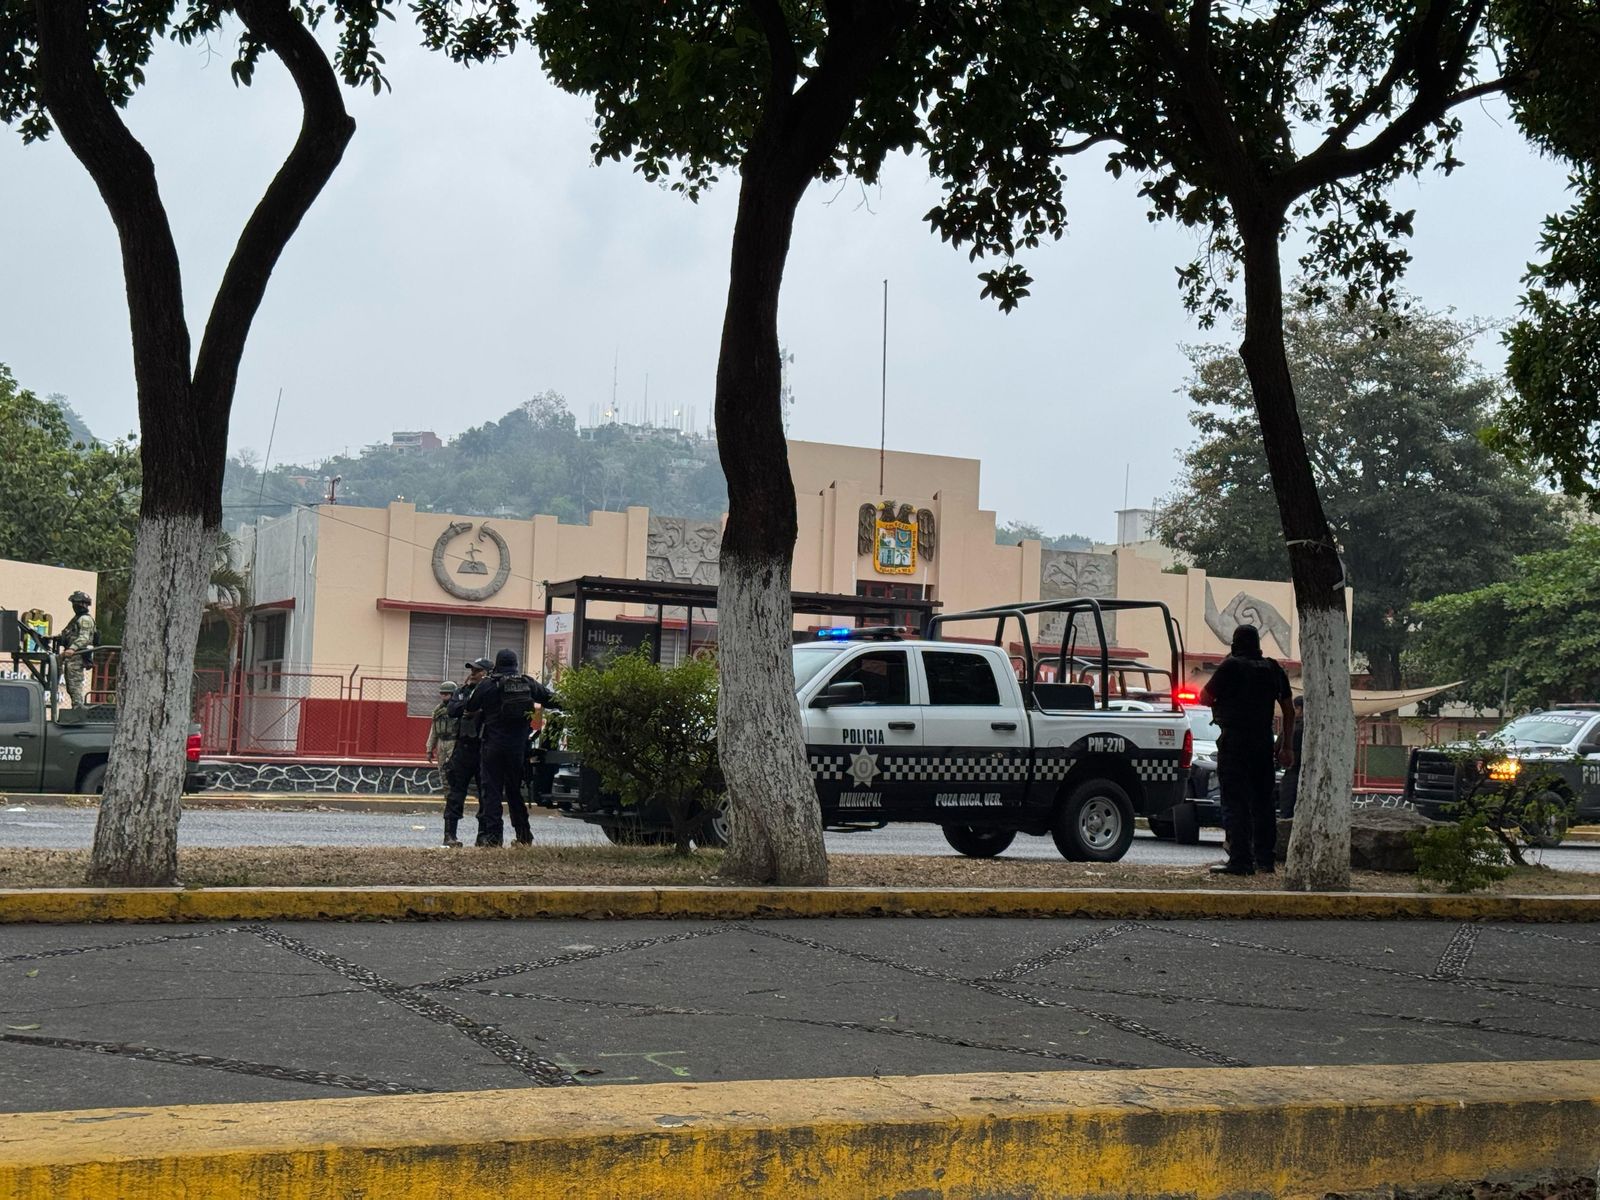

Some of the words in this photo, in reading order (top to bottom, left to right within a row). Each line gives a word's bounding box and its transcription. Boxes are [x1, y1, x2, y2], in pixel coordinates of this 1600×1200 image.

[588, 629, 623, 642] Hilux
[842, 728, 884, 744] POLICIA
[1088, 736, 1125, 753] PM-270
[839, 792, 882, 807] MUNICIPAL
[935, 793, 958, 807] POZA
[984, 793, 1003, 806] VER.
